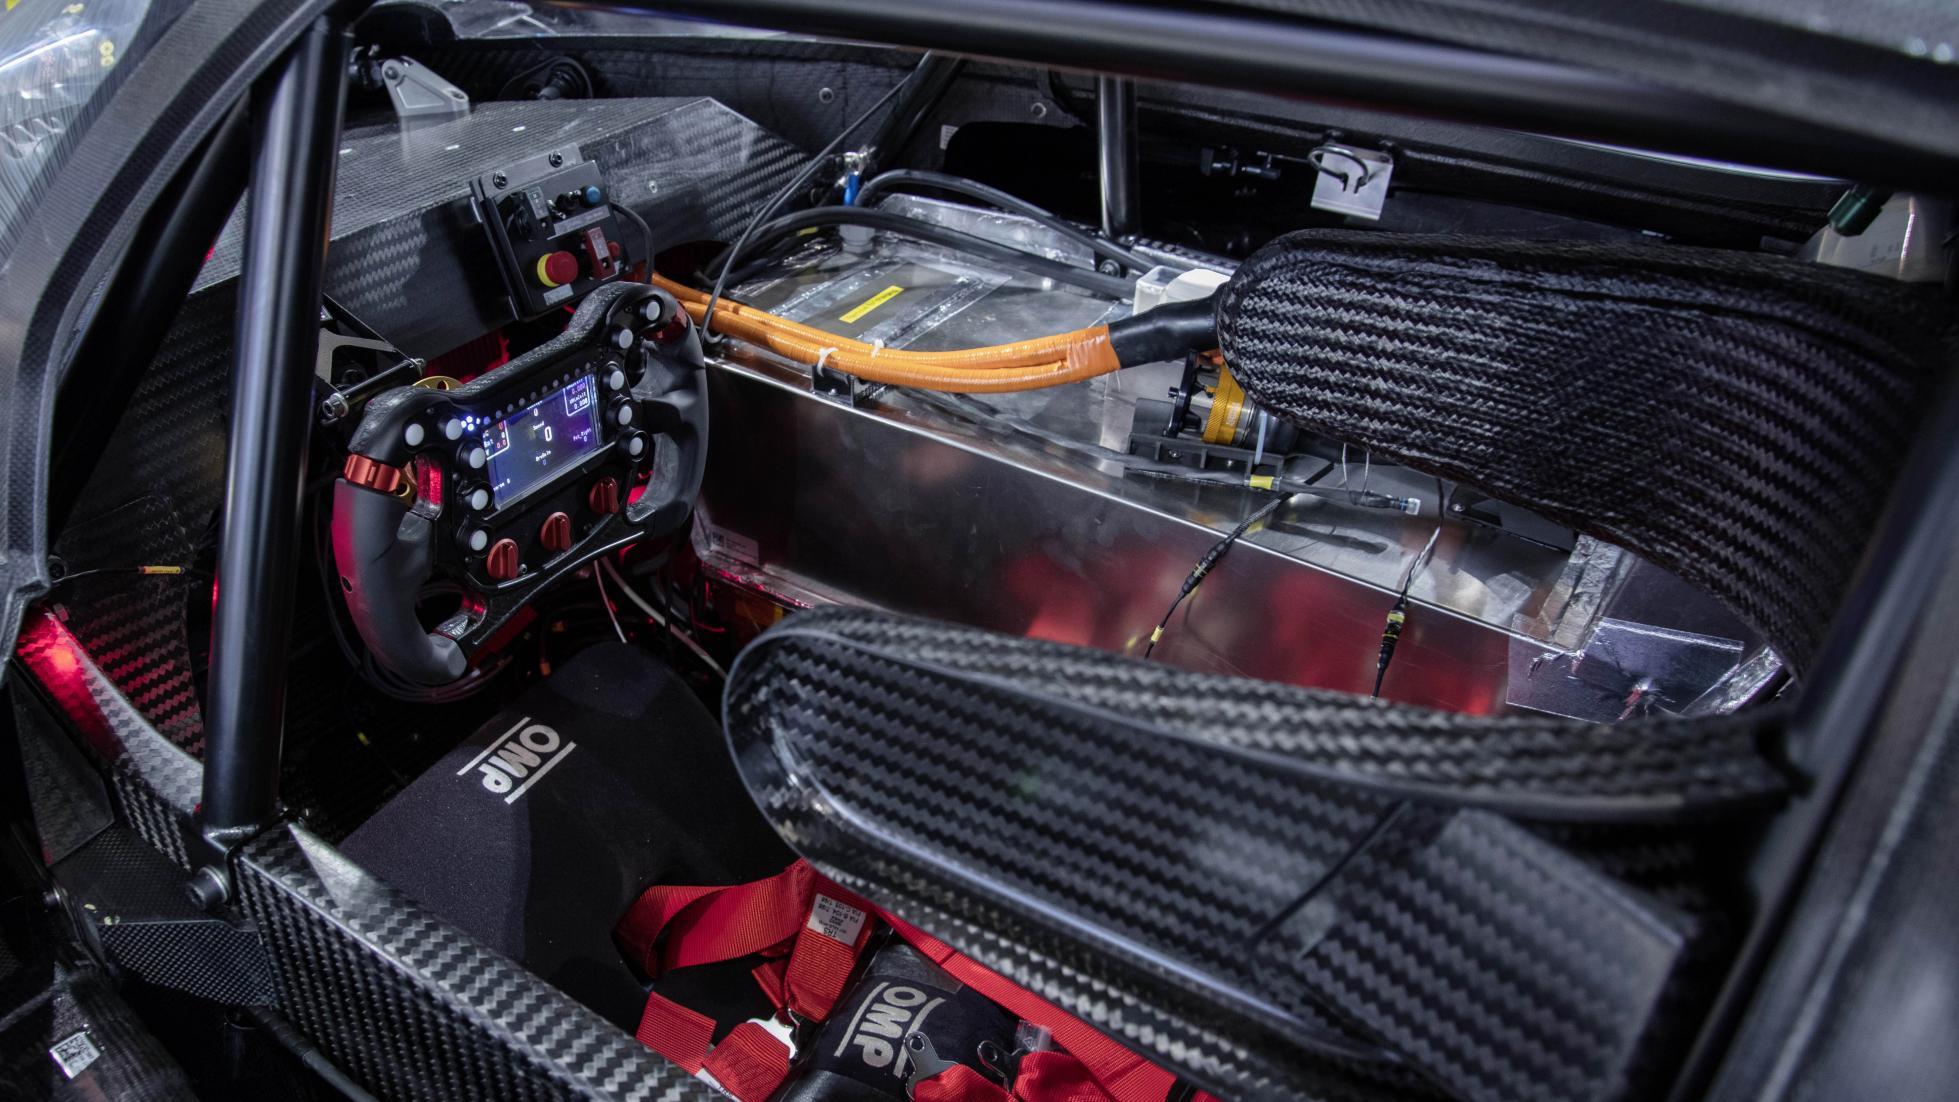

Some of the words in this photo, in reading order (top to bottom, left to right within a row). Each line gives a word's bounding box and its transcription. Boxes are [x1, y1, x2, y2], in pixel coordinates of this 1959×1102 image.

[544, 426, 552, 442] 0
[478, 724, 560, 793] OMP
[852, 986, 928, 1068] OMP
